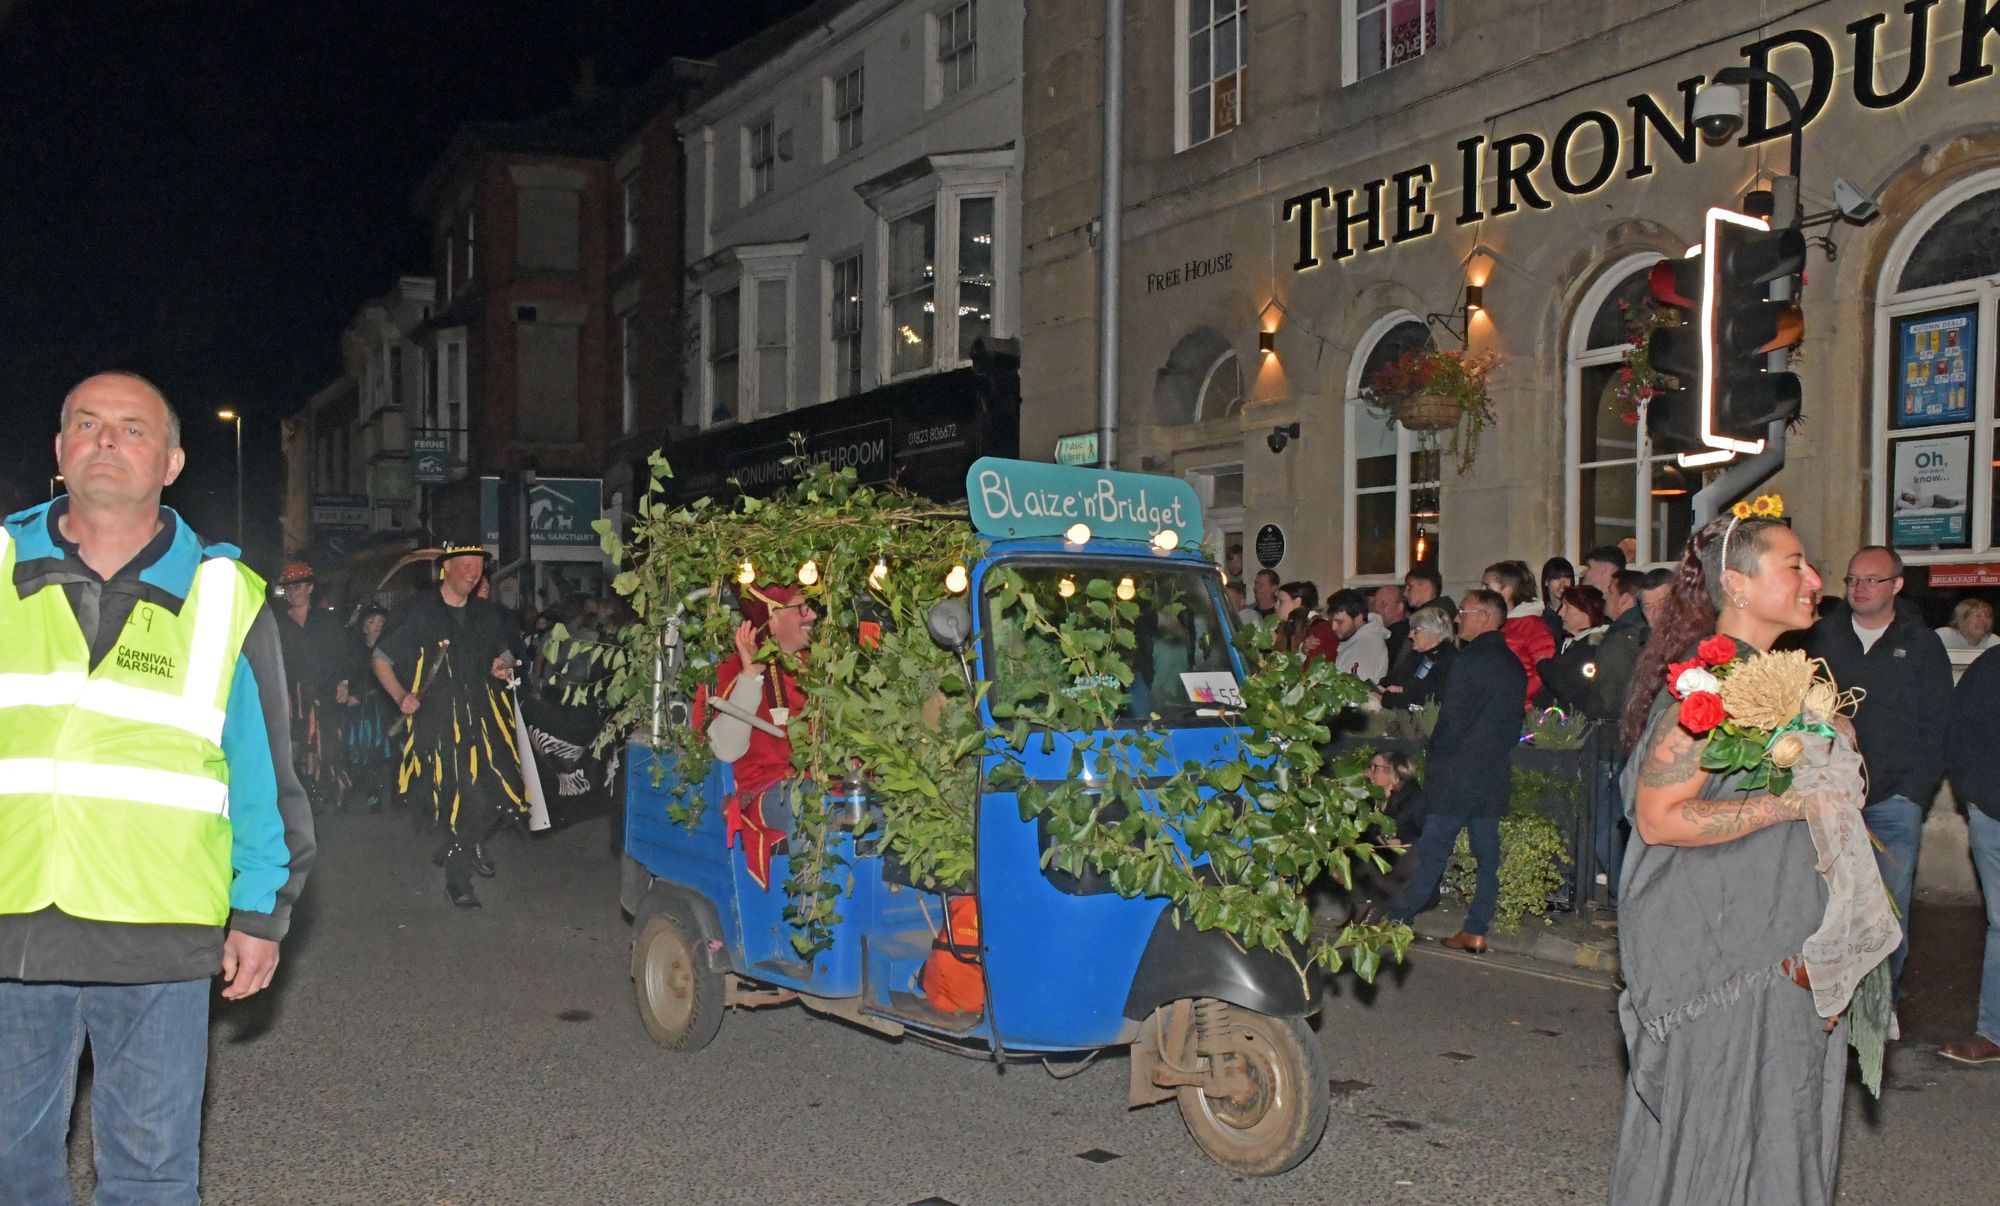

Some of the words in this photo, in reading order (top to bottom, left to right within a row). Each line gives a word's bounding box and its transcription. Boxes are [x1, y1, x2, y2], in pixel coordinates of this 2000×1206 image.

[1283, 164, 1437, 271] THE
[1456, 75, 1706, 226] IRON
[1147, 269, 1181, 293] FREE
[1185, 253, 1233, 281] HOUSE
[414, 440, 446, 449] FERNE
[908, 429, 929, 446] 01823
[1915, 451, 1948, 468] Oh,
[732, 460, 800, 487] MONUMEN
[1931, 575, 1978, 584] BREAKFAST
[116, 655, 174, 679] MARSHAL
[118, 645, 176, 668] CARNIVAL
